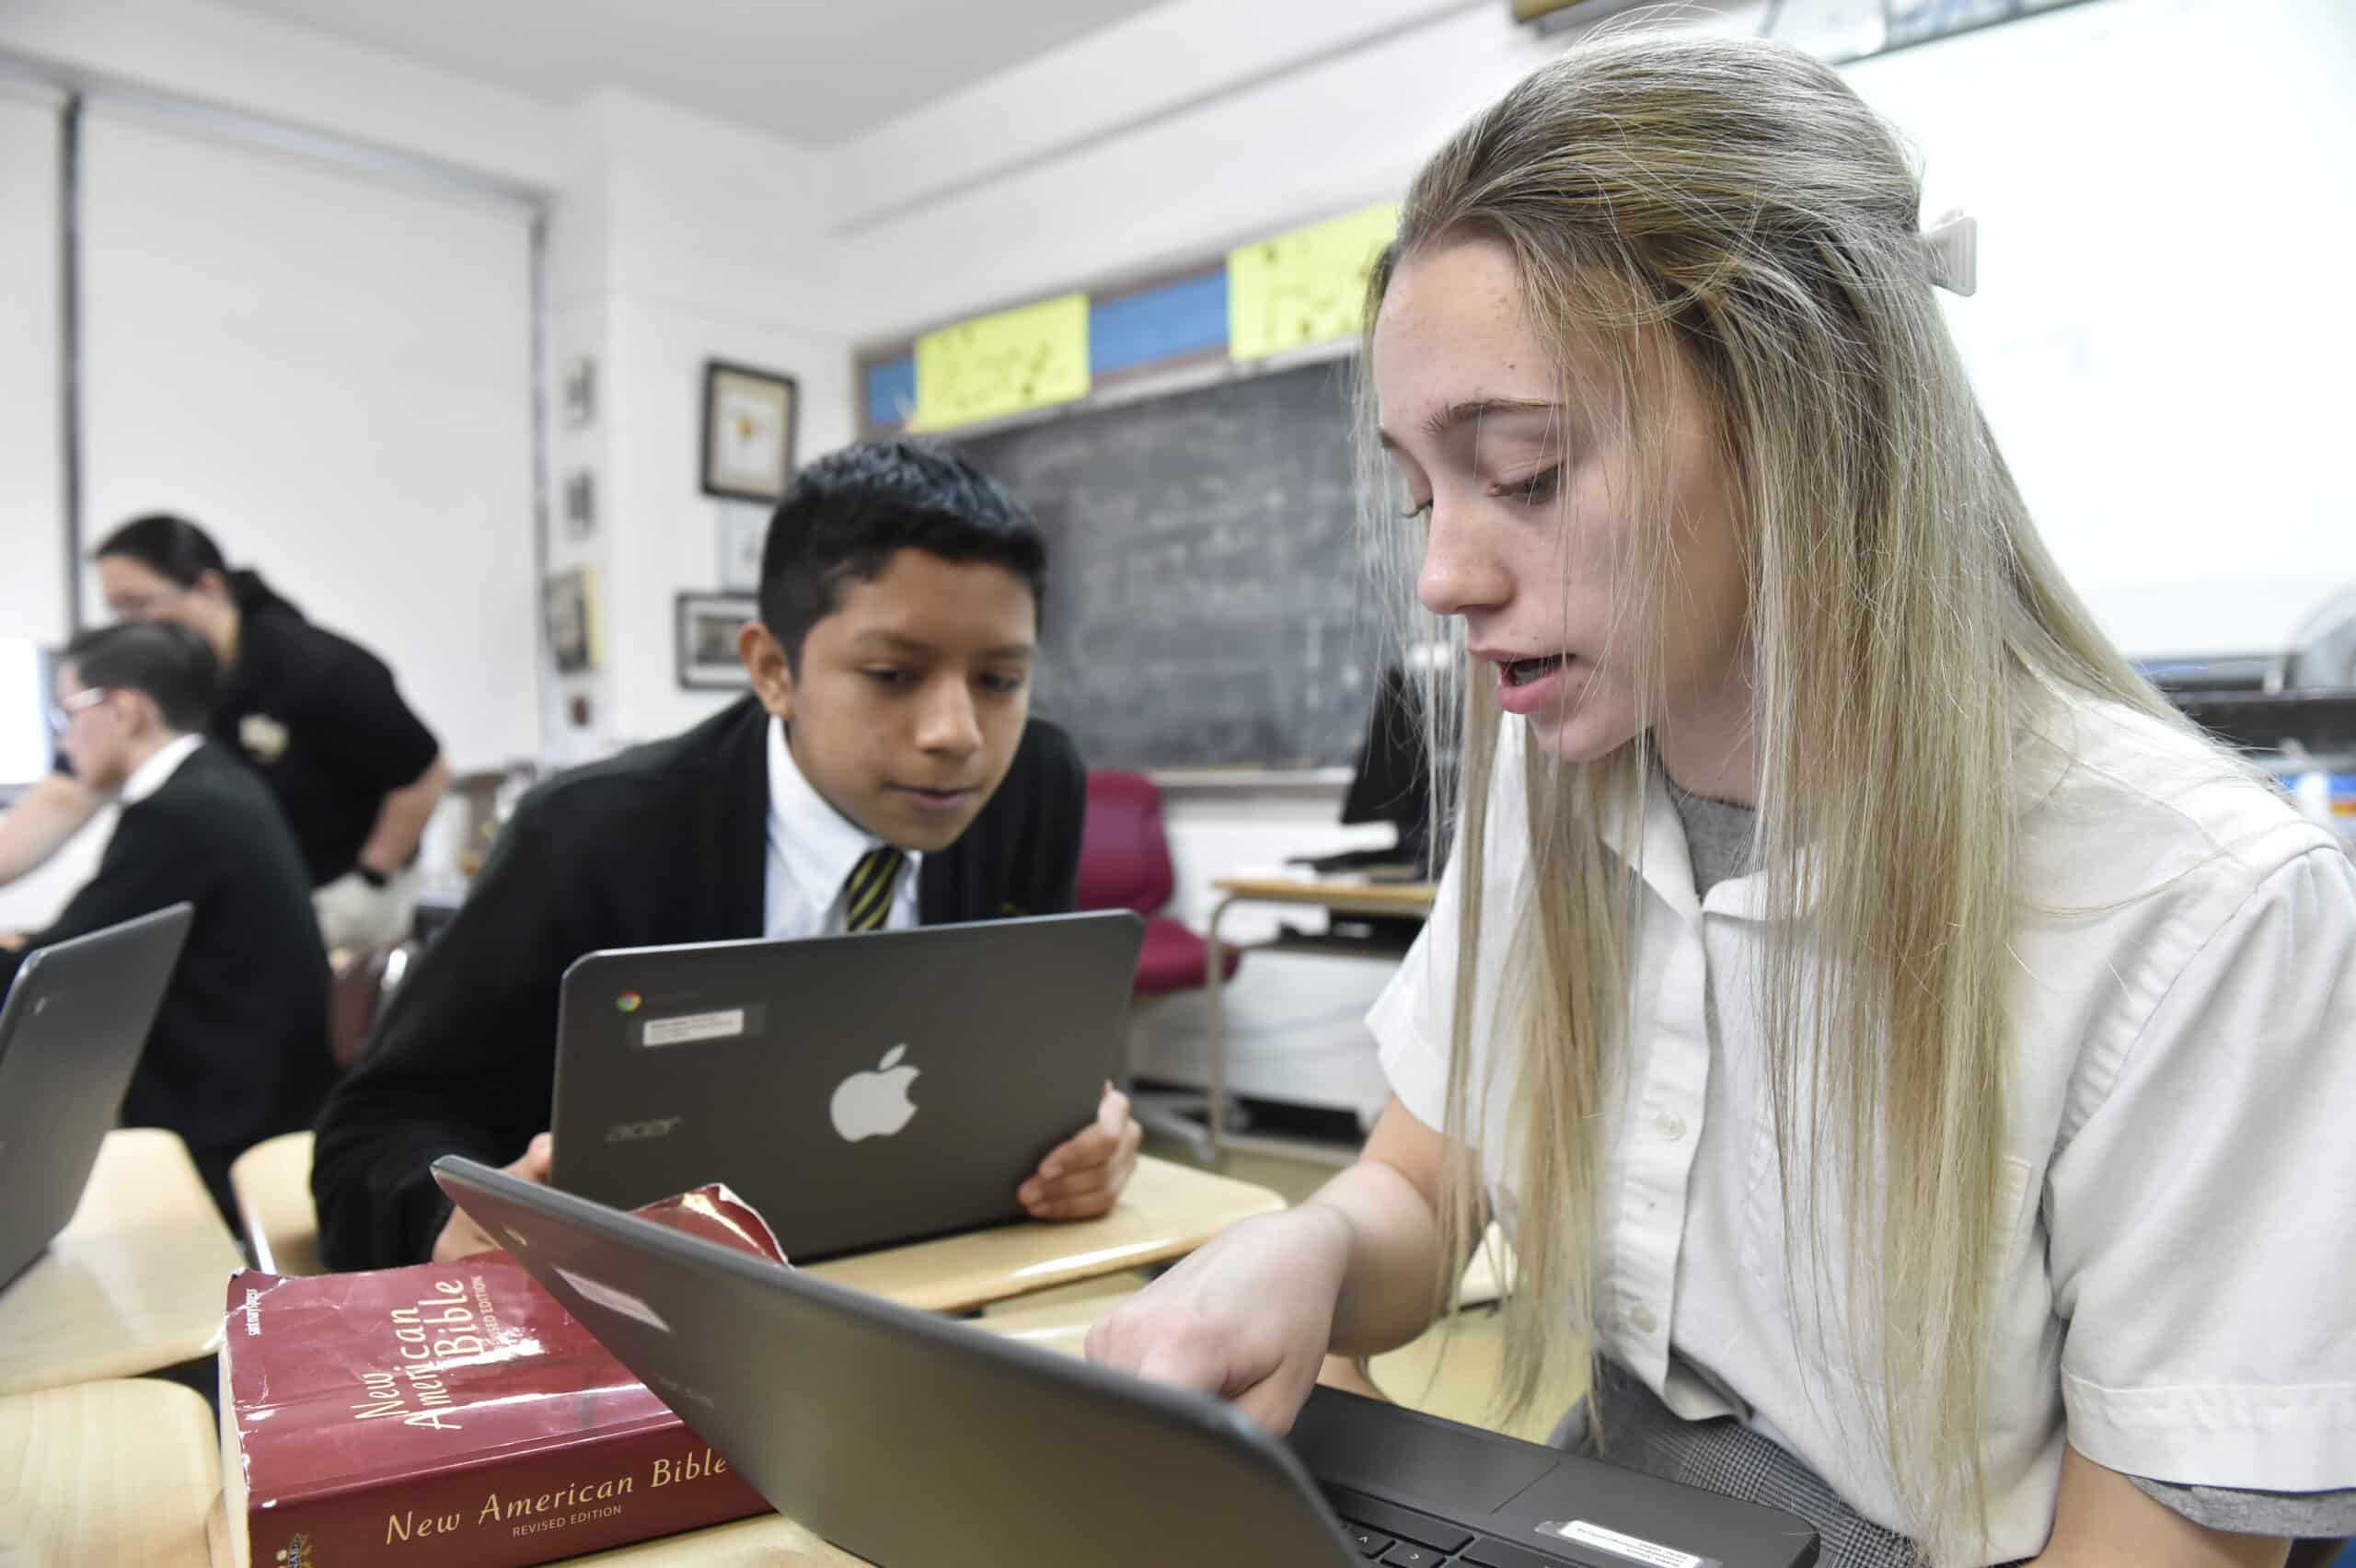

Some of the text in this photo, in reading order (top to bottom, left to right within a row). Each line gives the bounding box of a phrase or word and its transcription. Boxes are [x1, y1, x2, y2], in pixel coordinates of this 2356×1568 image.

[417, 1279, 485, 1357] Bible
[471, 1275, 493, 1315] EDITION
[350, 1372, 410, 1419] New
[390, 1307, 463, 1430] American
[385, 1447, 728, 1546] New American Bible
[512, 1505, 623, 1538] REVISED EDITION
